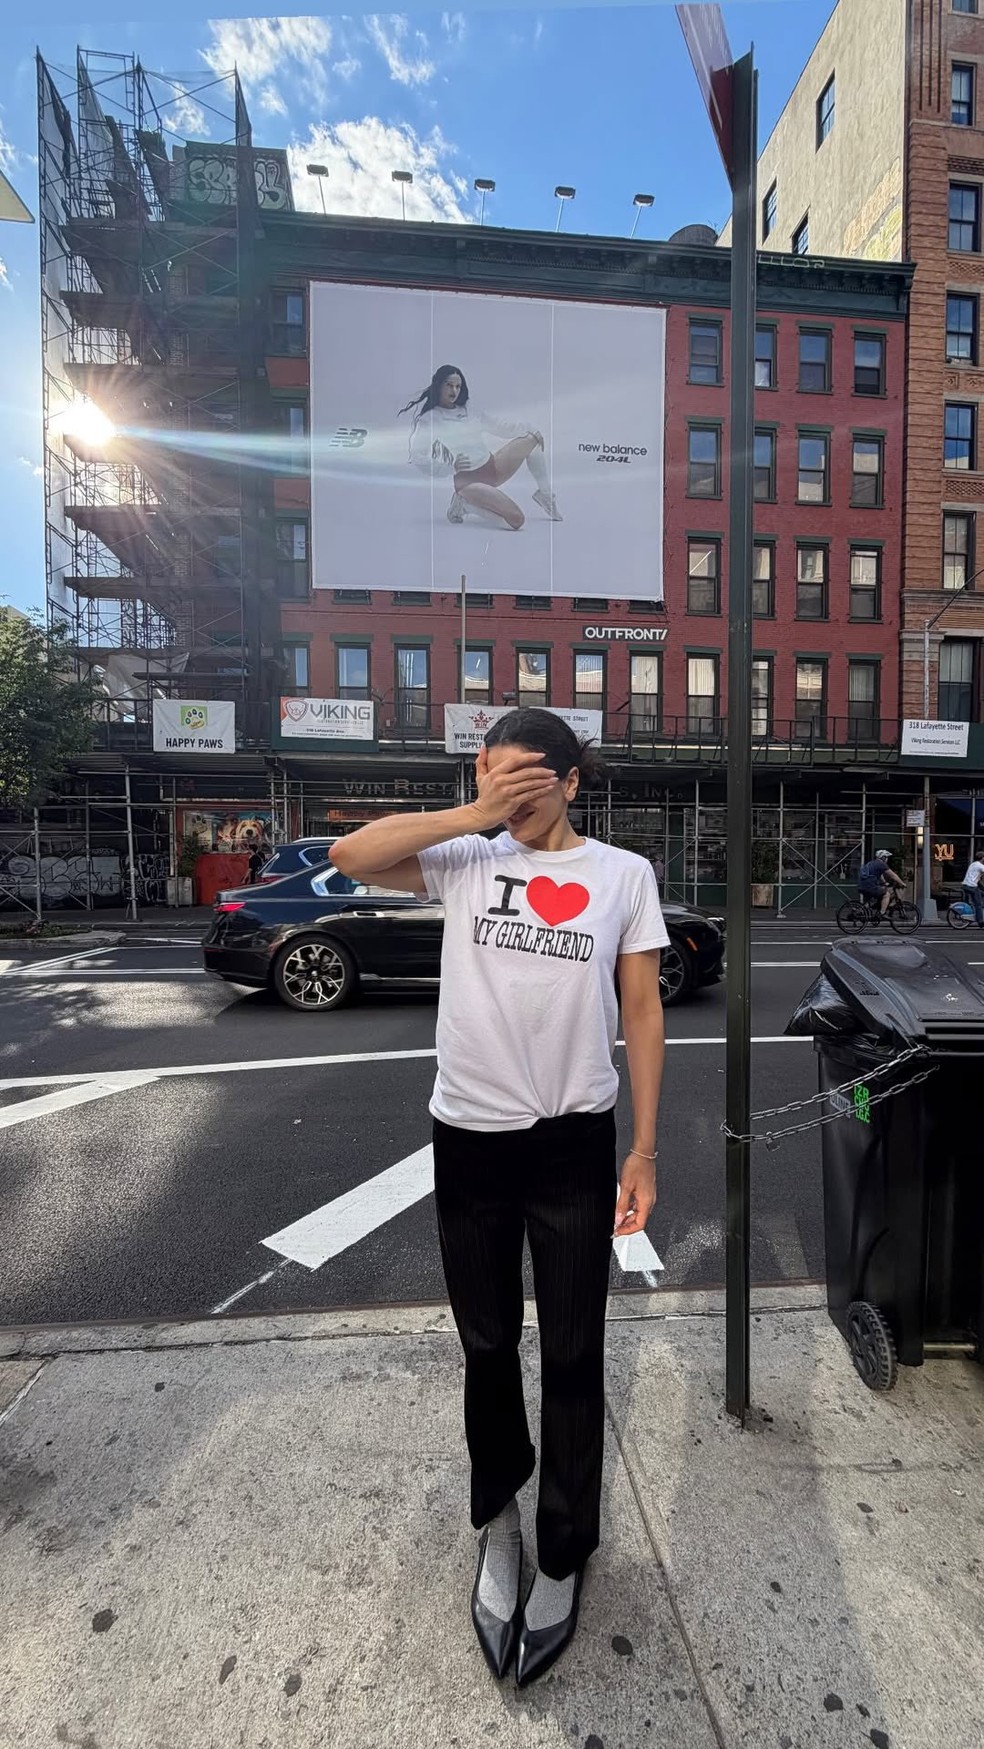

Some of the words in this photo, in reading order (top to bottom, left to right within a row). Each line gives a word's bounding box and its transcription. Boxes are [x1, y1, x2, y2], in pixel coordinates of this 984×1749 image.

[578, 443, 601, 453] new
[602, 443, 648, 456] balance
[596, 454, 631, 464] 204L
[310, 703, 371, 720] VIKING
[909, 721, 919, 729] 318
[920, 721, 946, 731] Lafayette
[947, 723, 964, 731] Street
[166, 737, 196, 748] HAPPY
[198, 738, 223, 749] PAWS
[454, 732, 467, 740] WIN
[468, 733, 484, 741] REST
[342, 778, 386, 795] WIN
[488, 875, 527, 916] I
[473, 916, 498, 946] MY
[495, 920, 594, 962] GIRLFRIEND
